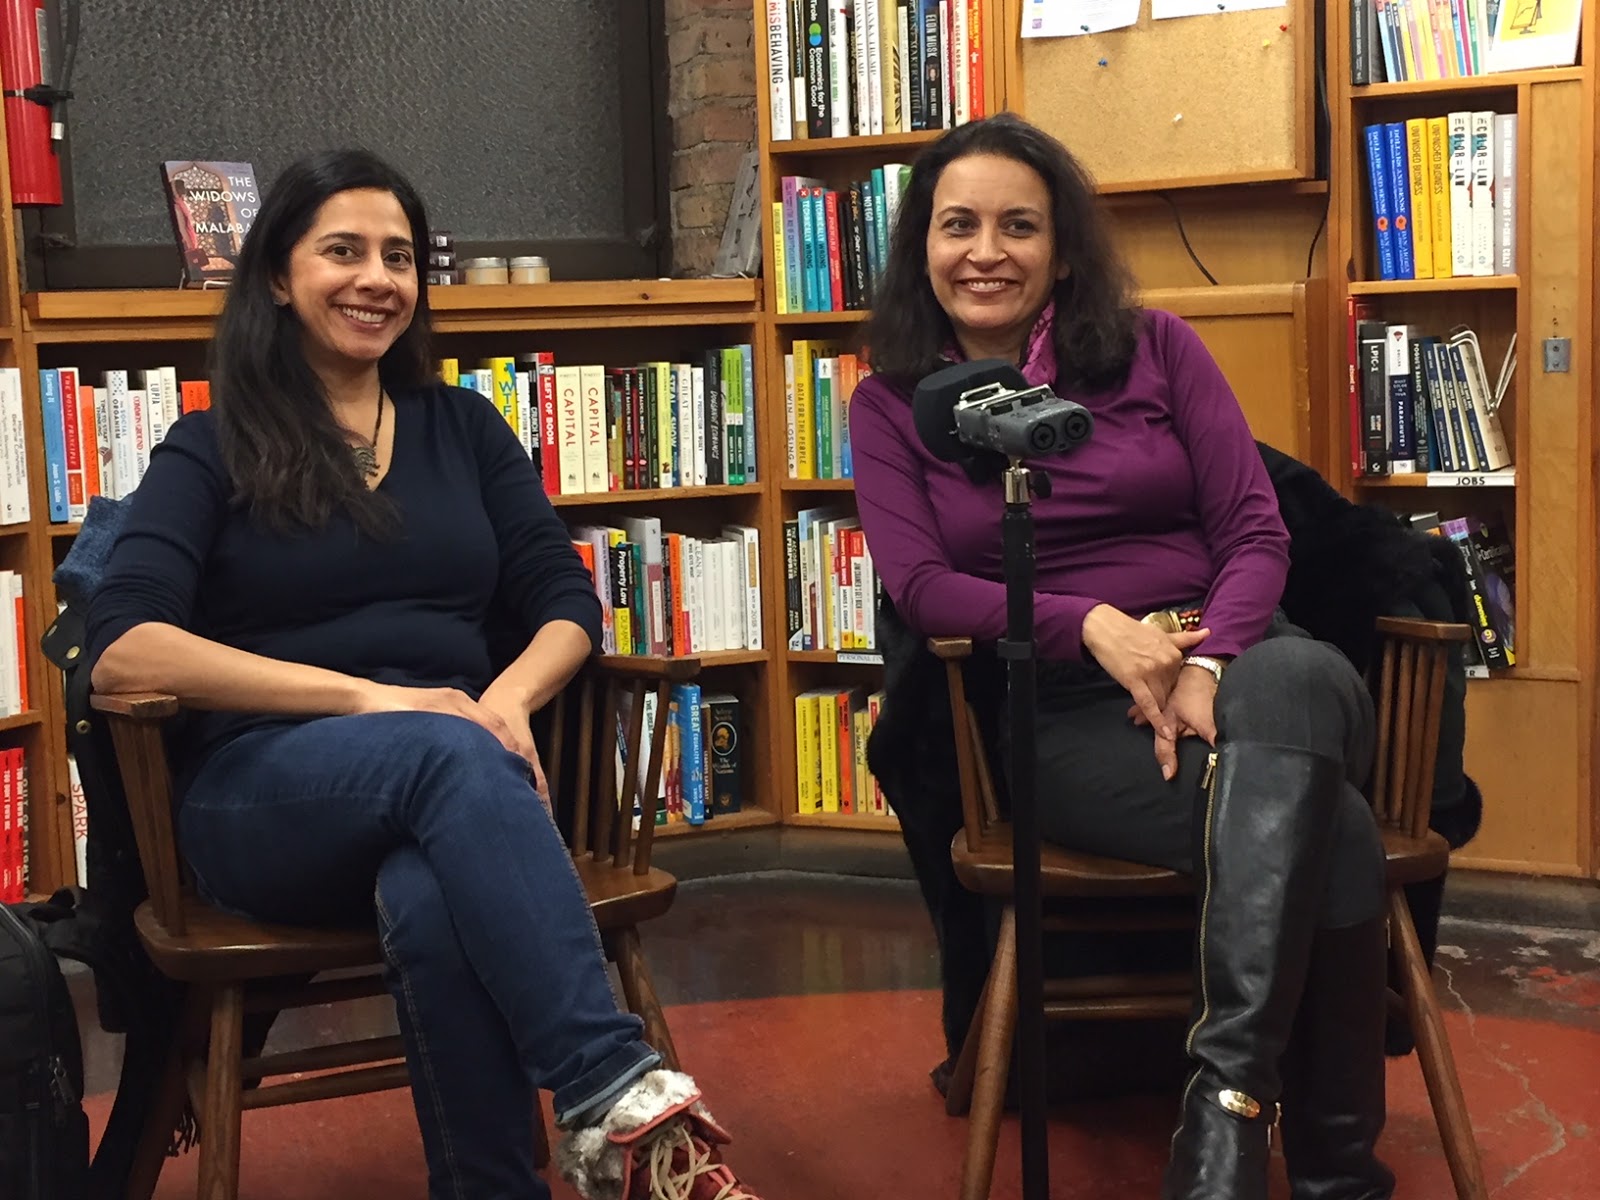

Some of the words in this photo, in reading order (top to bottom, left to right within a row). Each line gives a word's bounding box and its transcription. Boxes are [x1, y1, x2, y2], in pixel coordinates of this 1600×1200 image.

[926, 15, 936, 34] ELON
[926, 35, 937, 58] MUSK
[809, 48, 817, 84] Common
[815, 47, 824, 91] Economics
[1372, 131, 1381, 169] DOLLARS
[1394, 129, 1402, 168] DOLLARS
[228, 176, 252, 187] THE
[1375, 170, 1383, 188] AND
[1397, 169, 1405, 187] AND
[1454, 168, 1465, 187] LAW
[1477, 168, 1487, 187] LAW
[190, 191, 256, 203] WIDOWS
[863, 196, 872, 207] NO
[864, 207, 873, 222] EGO
[196, 222, 252, 234] MALABA
[805, 243, 814, 269] WRONG
[817, 243, 826, 269] WRONG
[1370, 345, 1379, 372] LPIC-1
[1413, 343, 1421, 374] POGUE'S
[45, 373, 54, 396] Earning
[63, 374, 71, 390] THE
[150, 383, 158, 405] LUPIA
[544, 377, 552, 402] LEFT
[681, 378, 689, 410] GREAT
[65, 391, 73, 421] MOSAIC
[133, 395, 142, 424] COMMON
[544, 402, 553, 415] OF
[786, 393, 795, 413] WIN
[112, 398, 121, 439] ORGANISM
[530, 407, 538, 433] CRUNCH
[563, 388, 576, 447] CAPITAL
[588, 387, 600, 446] CAPITAL
[135, 424, 143, 451] GROUND
[531, 433, 539, 448] TIME
[546, 416, 554, 446] BOOM
[669, 416, 678, 447] SHOW
[787, 423, 795, 460] LOSING
[67, 424, 76, 466] PRINCIPLE
[799, 436, 807, 465] PEOPLE
[1456, 477, 1486, 486] JOBS
[618, 551, 629, 586] Property
[694, 546, 702, 567] LEAN
[620, 587, 628, 606] Law
[690, 704, 700, 733] GREAT
[72, 783, 88, 840] SPARK
